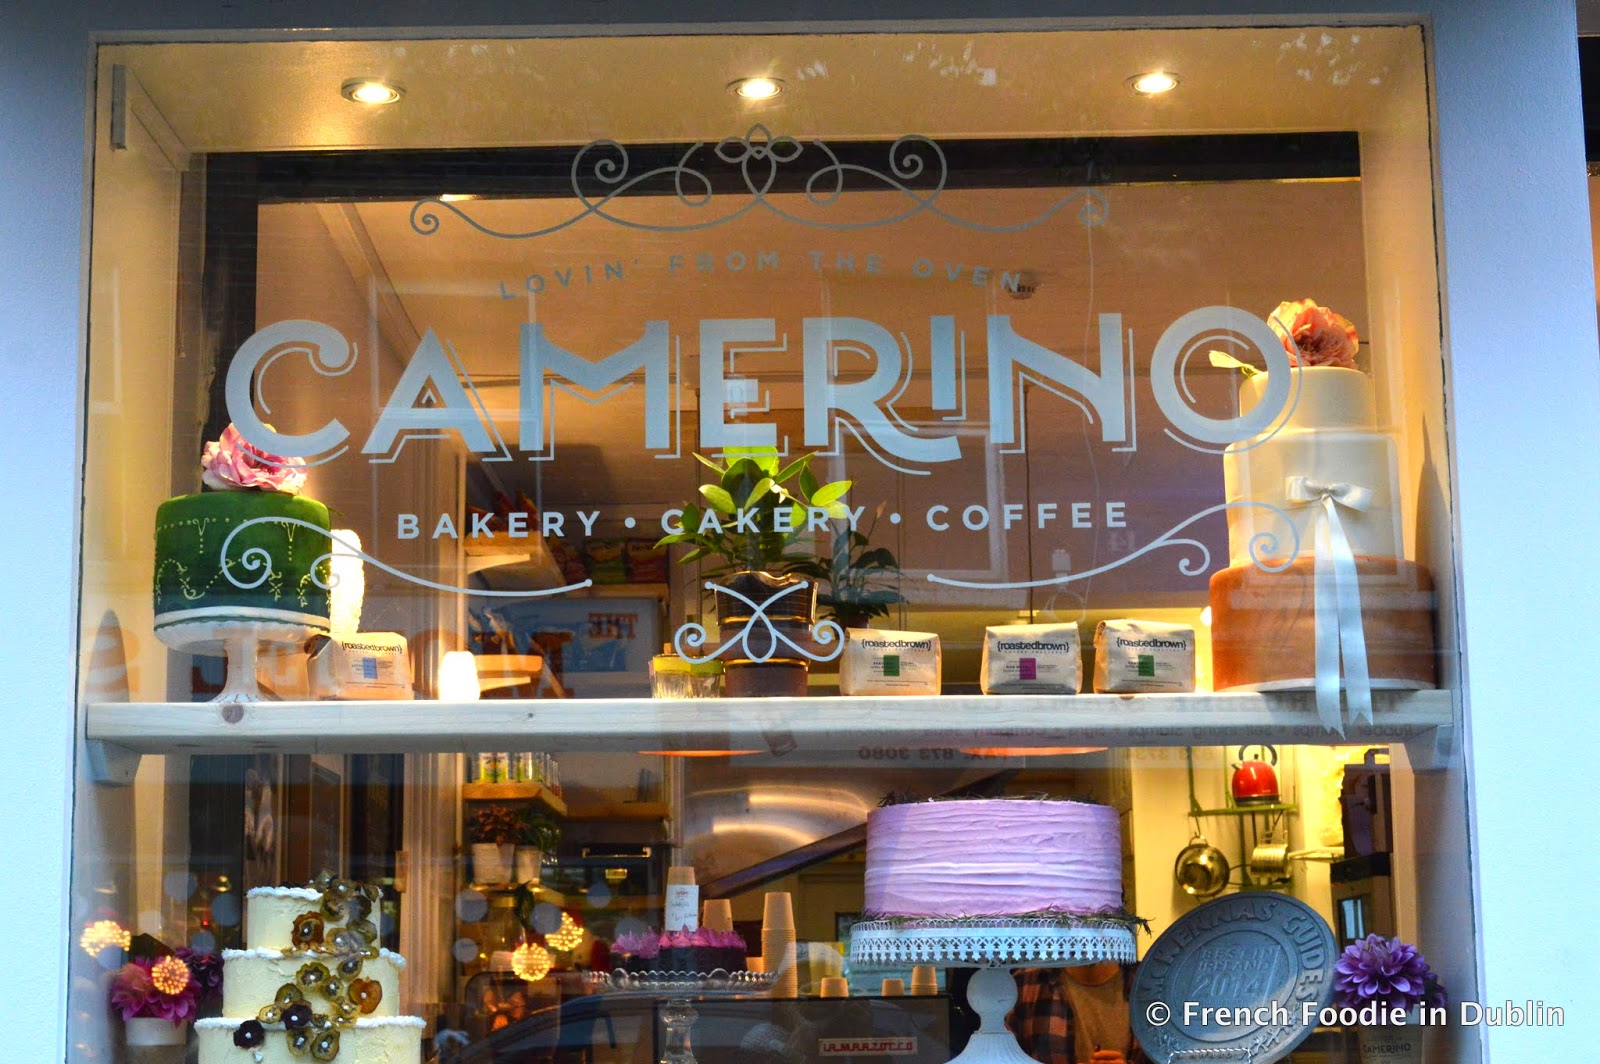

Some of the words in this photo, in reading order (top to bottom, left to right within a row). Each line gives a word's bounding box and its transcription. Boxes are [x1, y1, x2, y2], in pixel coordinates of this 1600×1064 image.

[668, 251, 778, 273] FROM
[808, 251, 883, 274] THE
[911, 258, 1021, 293] OVEN
[225, 305, 1302, 475] CAMERINO
[397, 510, 600, 540] BAKERY
[660, 506, 866, 536] CAKERY
[926, 502, 1127, 532] COFFEE
[1282, 916, 1326, 1001] GUIDES
[1191, 972, 1262, 998] 2014
